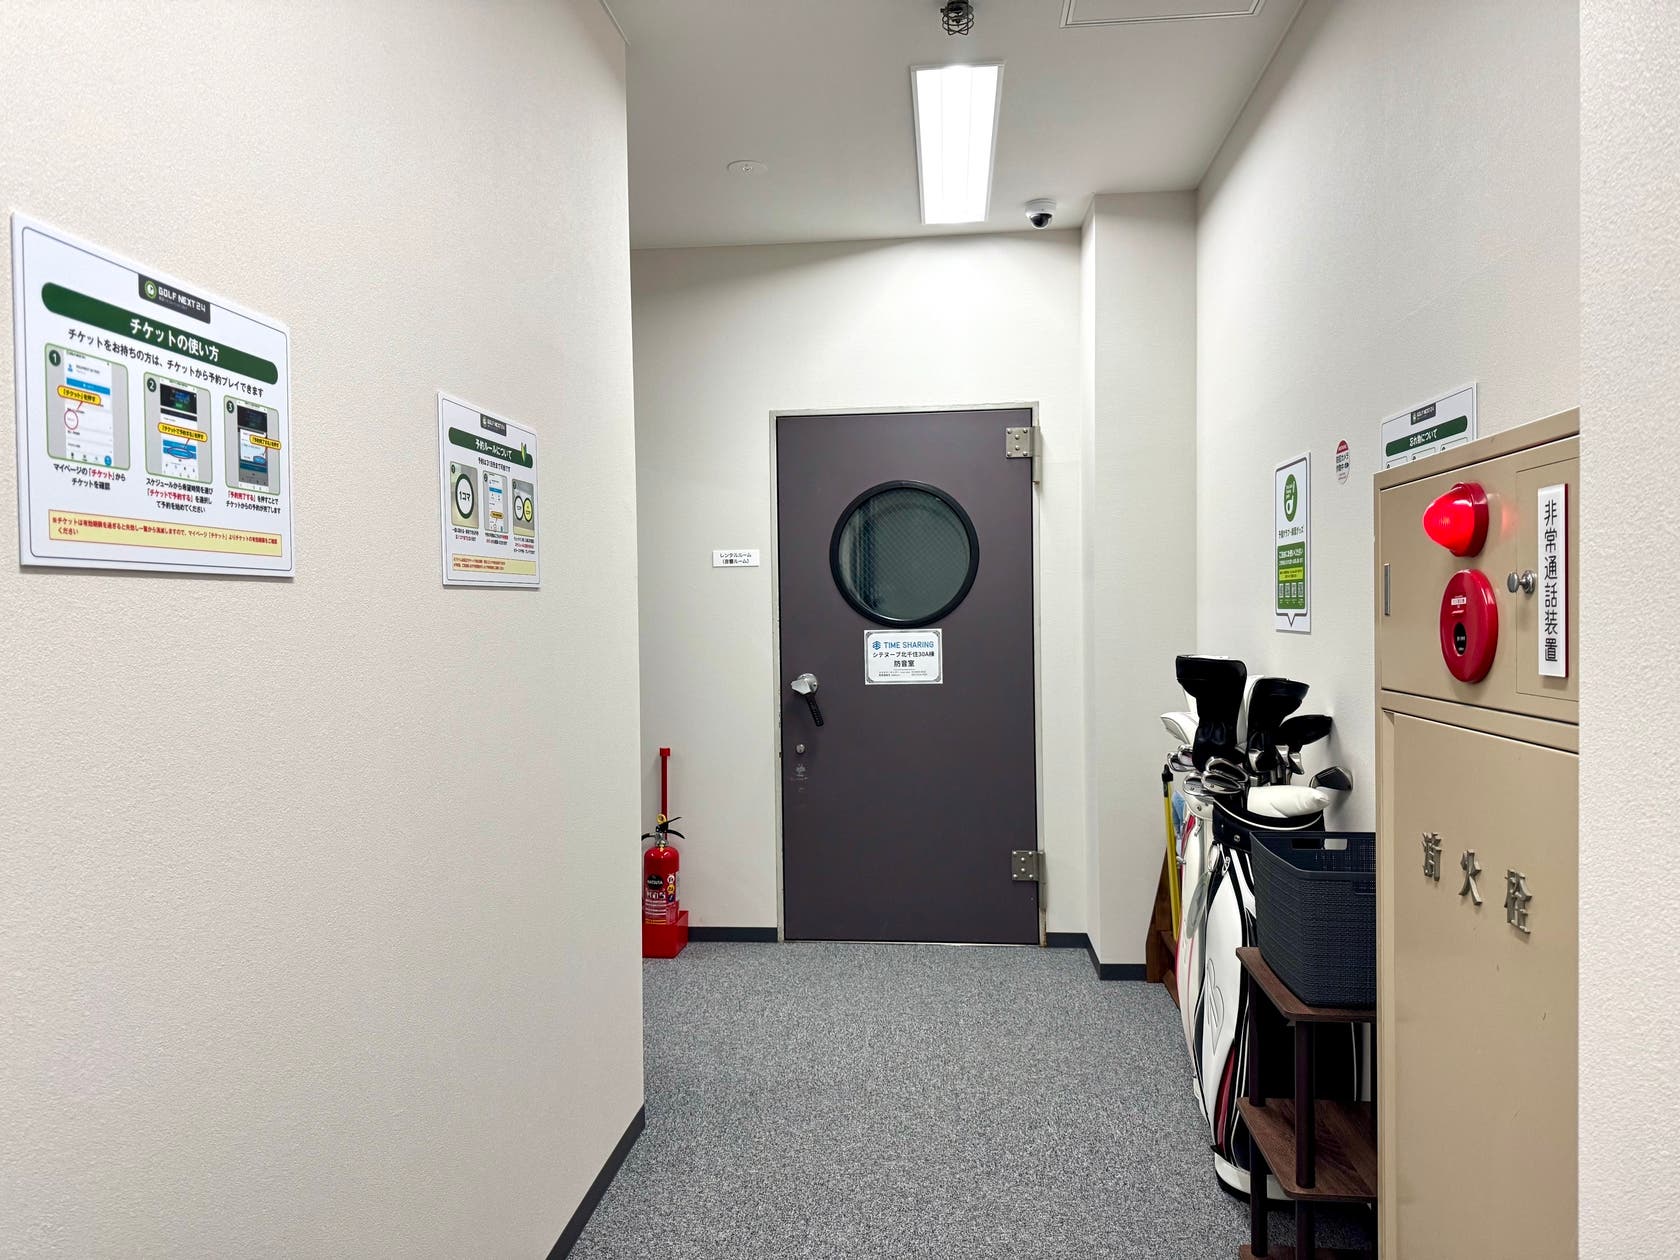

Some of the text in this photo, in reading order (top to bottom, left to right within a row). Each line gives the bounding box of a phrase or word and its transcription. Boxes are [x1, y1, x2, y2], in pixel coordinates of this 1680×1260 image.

[158, 286, 178, 301] GOLF
[177, 294, 196, 310] NEXT
[195, 302, 207, 313] 24
[129, 318, 220, 363] チケットの使い方
[67, 328, 265, 398] チケットをお持ちの方は、チケットから予約プレイできます
[459, 491, 471, 502] 1コマ
[58, 527, 79, 536] ください
[1544, 499, 1558, 662] 非常通話装置
[883, 641, 935, 649] TIME SHARING
[893, 659, 916, 667] 防音室
